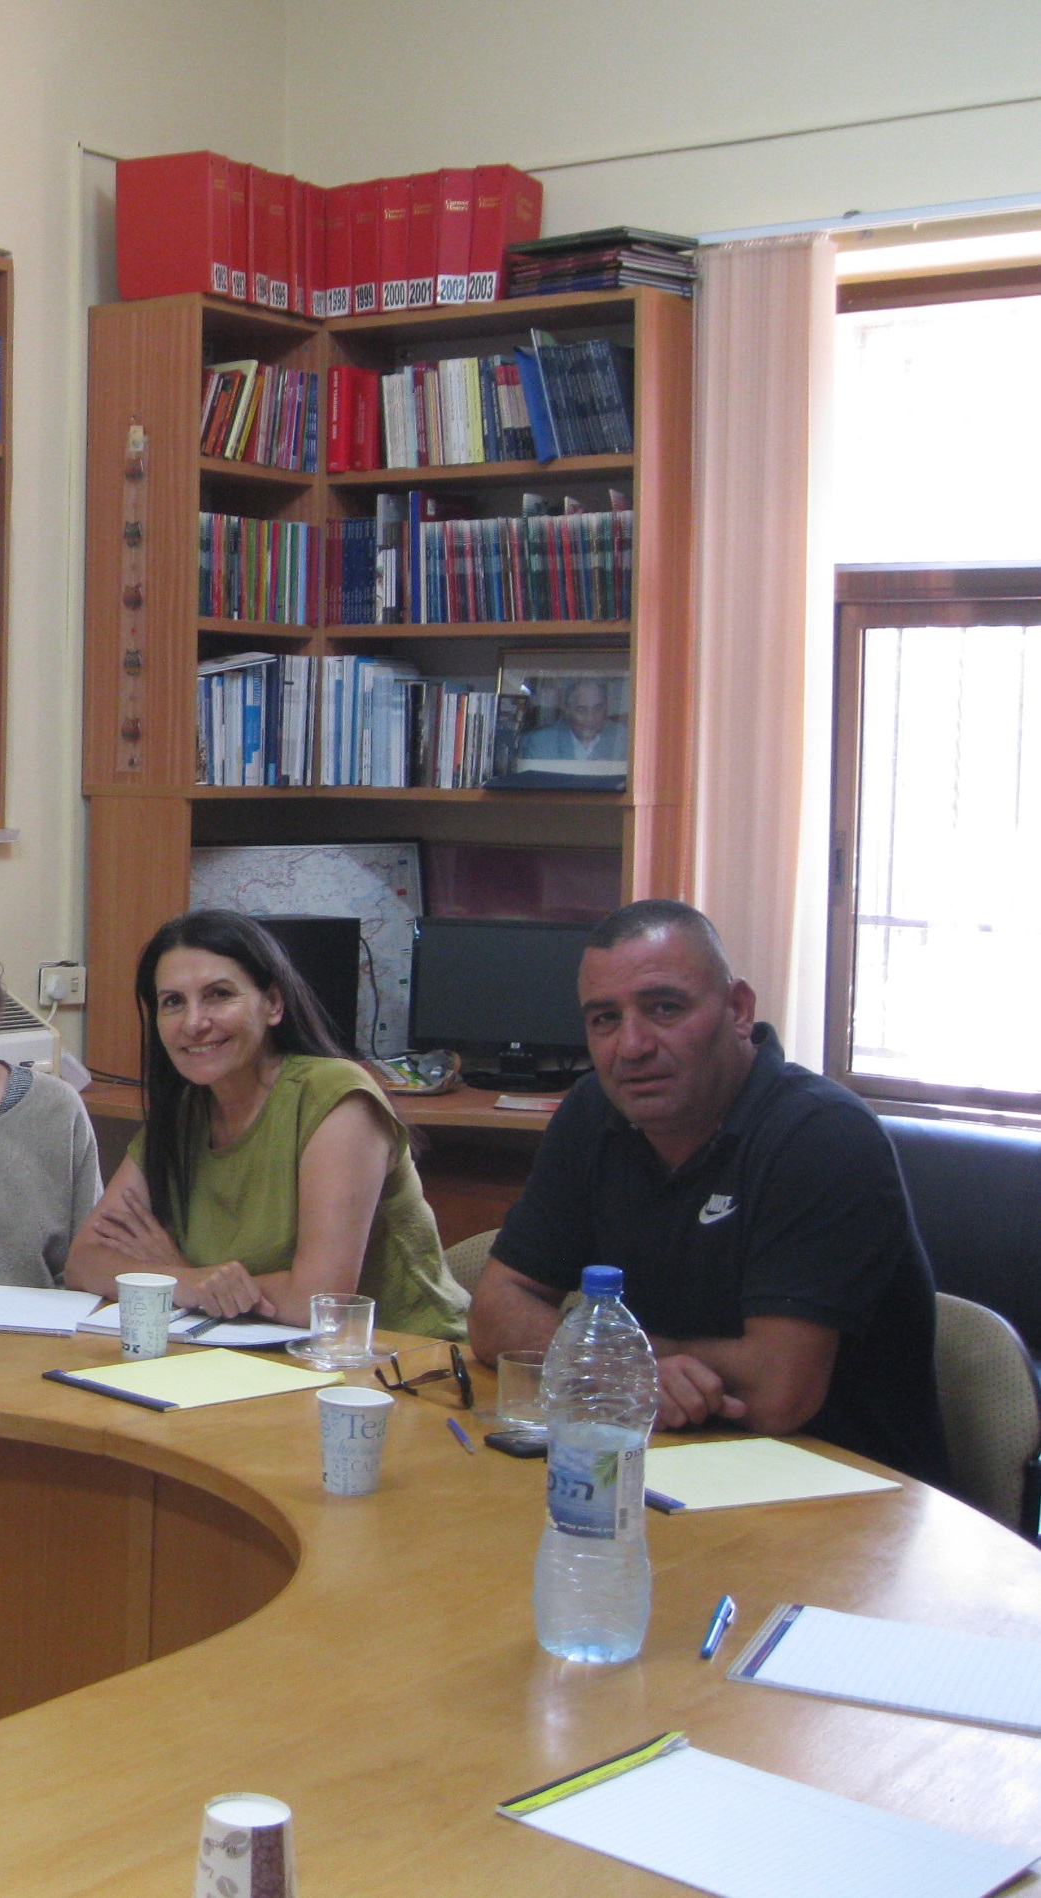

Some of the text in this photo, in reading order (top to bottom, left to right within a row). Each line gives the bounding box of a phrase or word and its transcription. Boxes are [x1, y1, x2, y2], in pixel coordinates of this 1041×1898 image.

[445, 198, 470, 207] Current
[446, 204, 469, 212] History
[355, 284, 374, 308] 1999
[384, 283, 405, 307] 2000
[409, 280, 432, 303] 2001
[440, 278, 465, 300] 2002
[469, 275, 494, 299] 2003
[708, 1194, 733, 1212] NIKE
